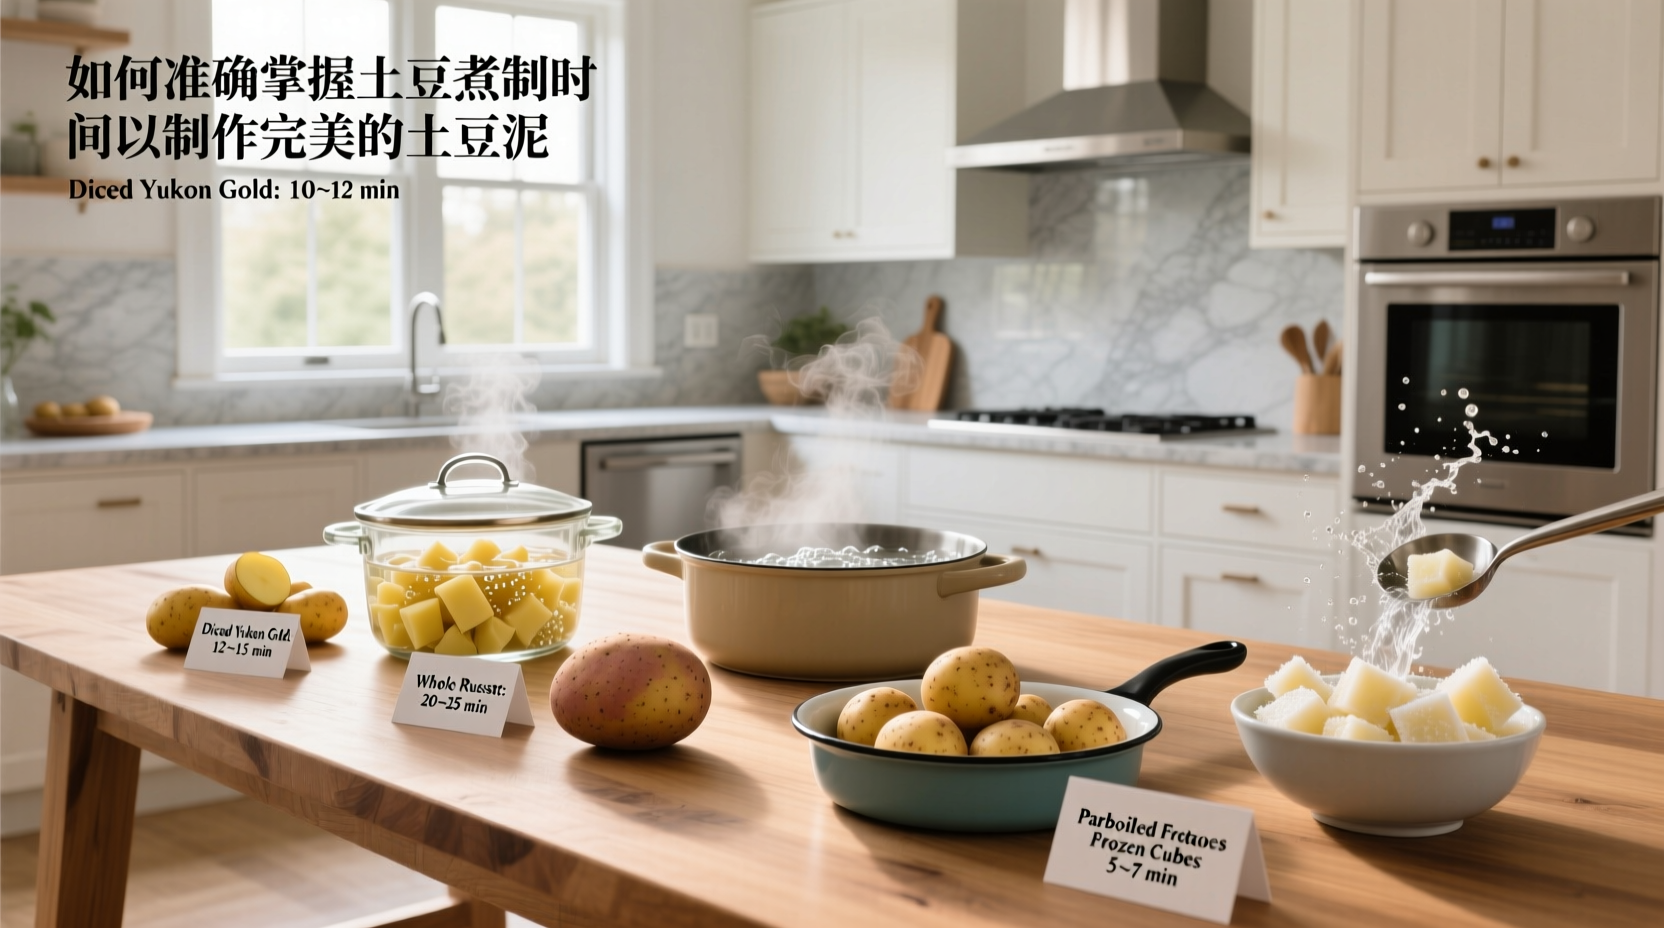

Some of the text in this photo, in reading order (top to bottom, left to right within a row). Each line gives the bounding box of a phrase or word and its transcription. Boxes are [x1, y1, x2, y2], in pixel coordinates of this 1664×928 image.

[251, 645, 272, 658] min
[463, 699, 488, 714] min
[1078, 808, 1158, 838] Parboiled
[1150, 844, 1202, 869] Cubes
[1106, 857, 1178, 887] 5~7 min
